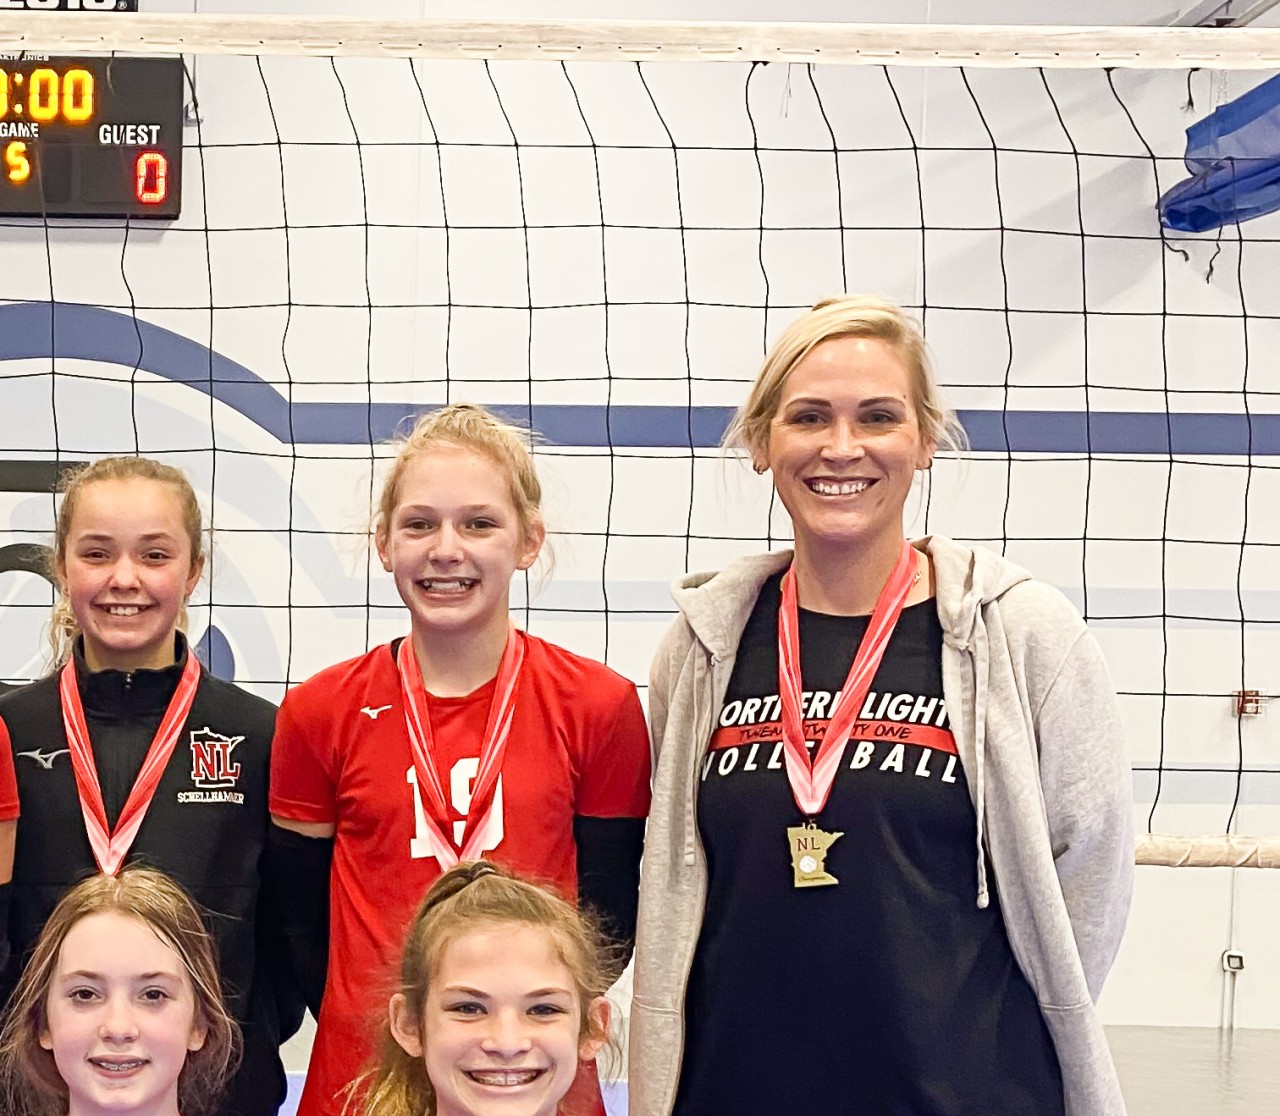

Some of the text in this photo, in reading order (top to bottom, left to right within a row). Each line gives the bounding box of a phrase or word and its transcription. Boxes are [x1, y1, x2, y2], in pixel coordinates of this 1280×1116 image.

[99, 124, 160, 145] GUEST
[136, 151, 167, 203] 0
[719, 690, 950, 732] ORTER LIGHT
[739, 723, 912, 741] TWEN TWTY ONE
[191, 741, 240, 780] NL
[702, 739, 957, 784] VOLLBALL
[796, 837, 821, 852] NL
